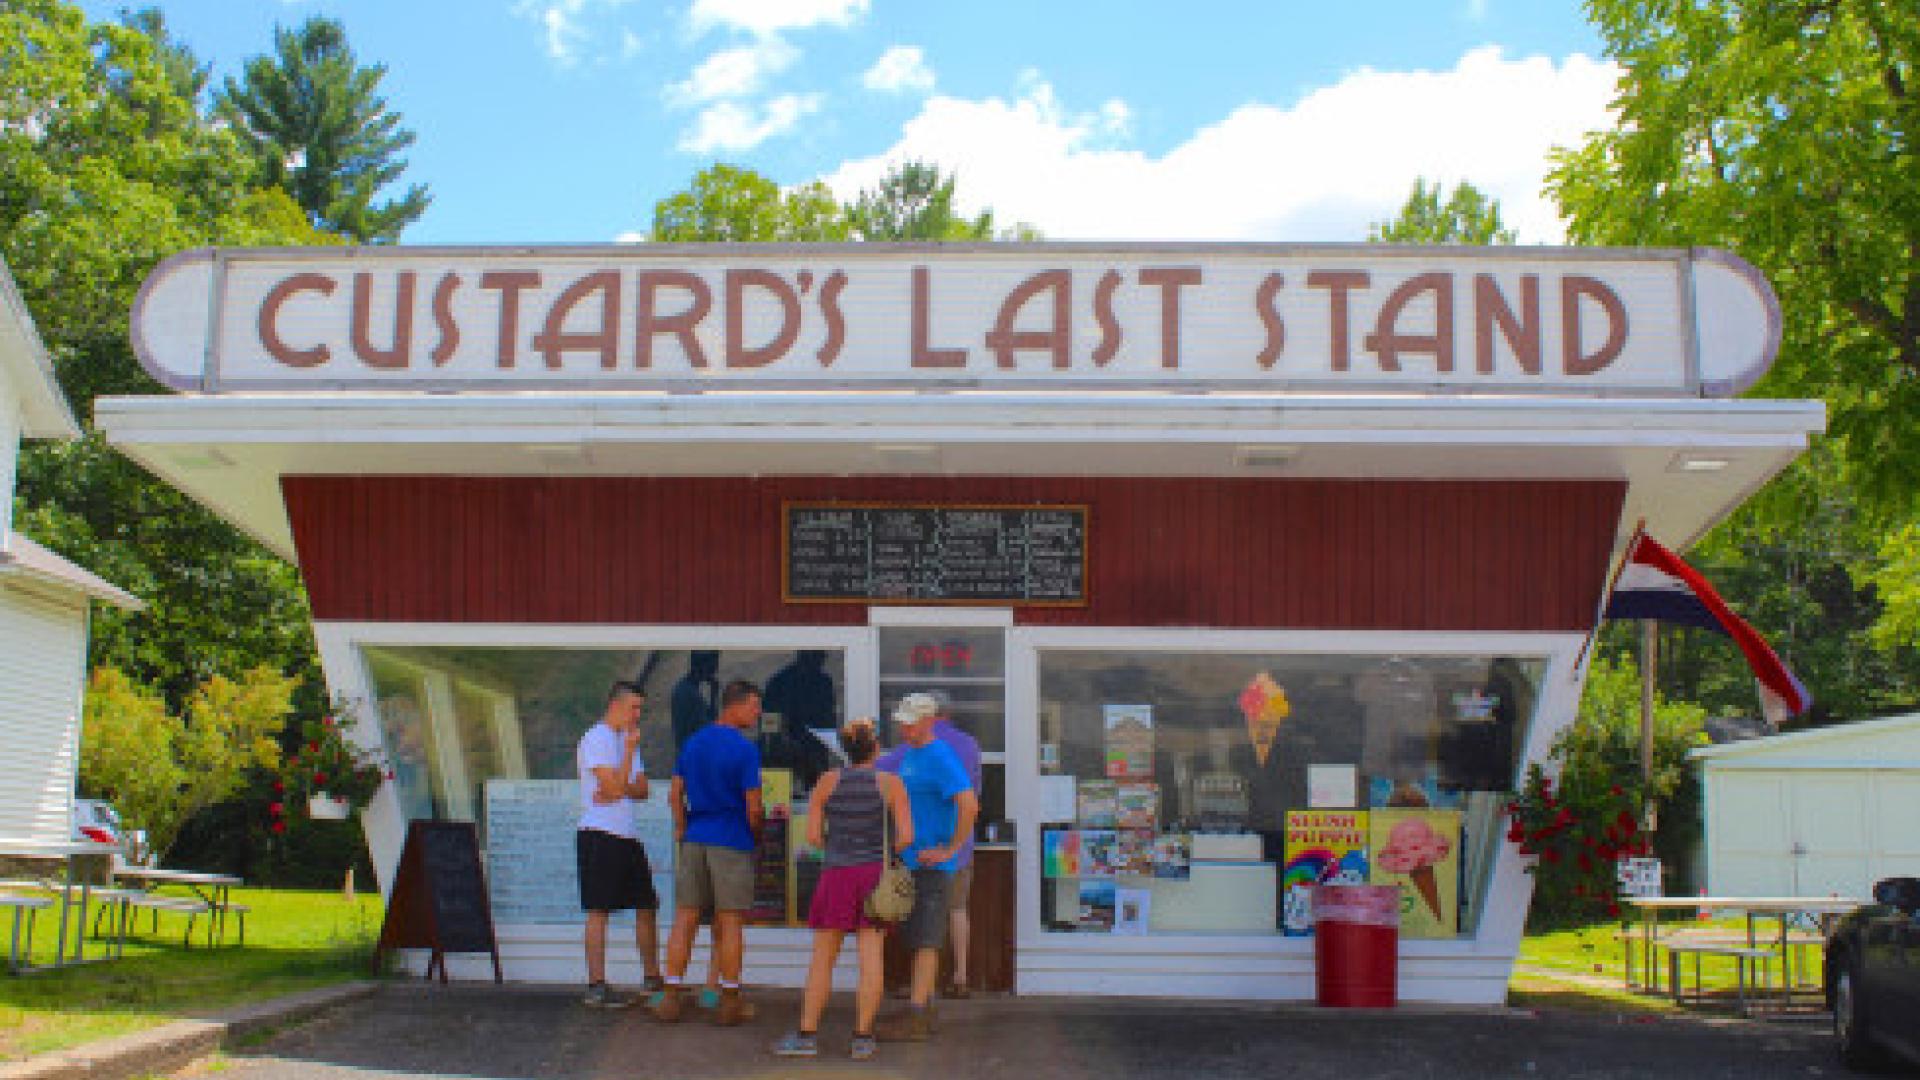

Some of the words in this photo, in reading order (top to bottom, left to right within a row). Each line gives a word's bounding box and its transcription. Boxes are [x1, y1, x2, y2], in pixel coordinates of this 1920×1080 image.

[257, 268, 849, 370] CUSTARD'S
[910, 266, 1202, 371] LAST
[1255, 270, 1630, 376] STAND
[908, 643, 976, 669] OPEN
